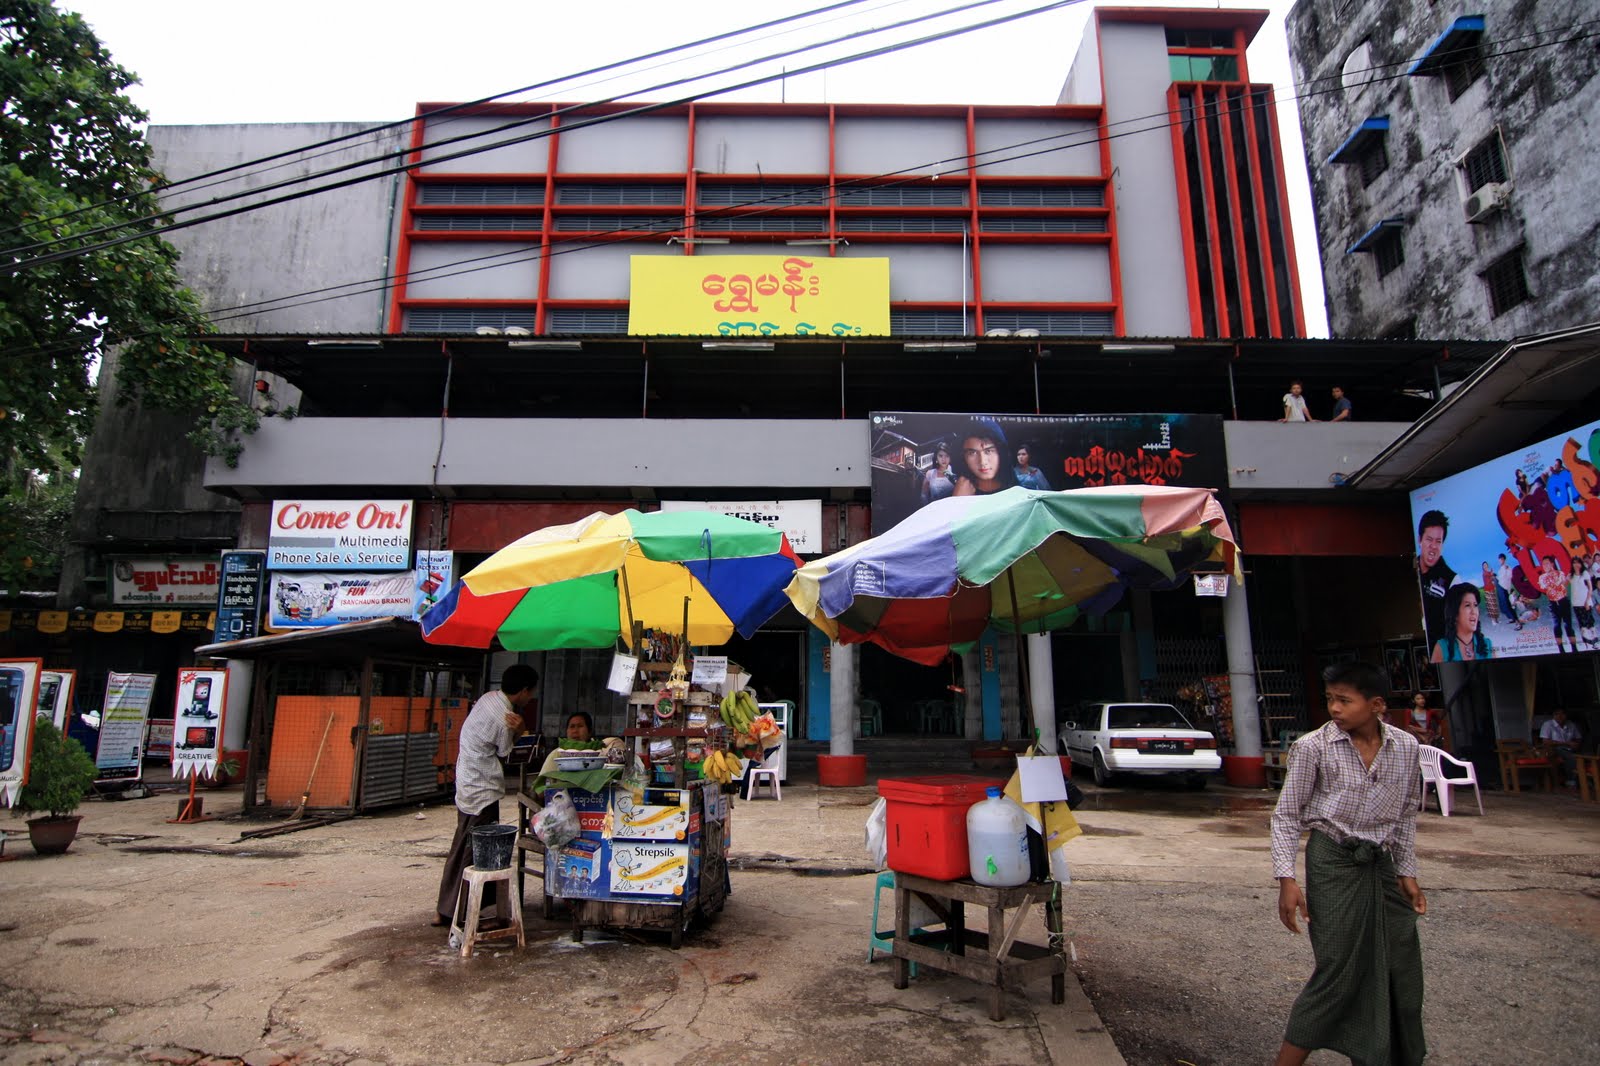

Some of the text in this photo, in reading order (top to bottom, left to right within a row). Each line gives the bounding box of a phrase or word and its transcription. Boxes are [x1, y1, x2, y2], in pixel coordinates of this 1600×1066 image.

[277, 503, 409, 530] Come On!
[339, 535, 409, 547] Multimedia
[274, 552, 403, 564] Phone Sale & Service
[340, 579, 371, 587] mobile
[346, 587, 367, 596] FUN
[381, 597, 411, 605] BRANCH)
[635, 846, 675, 858] Strepsils
